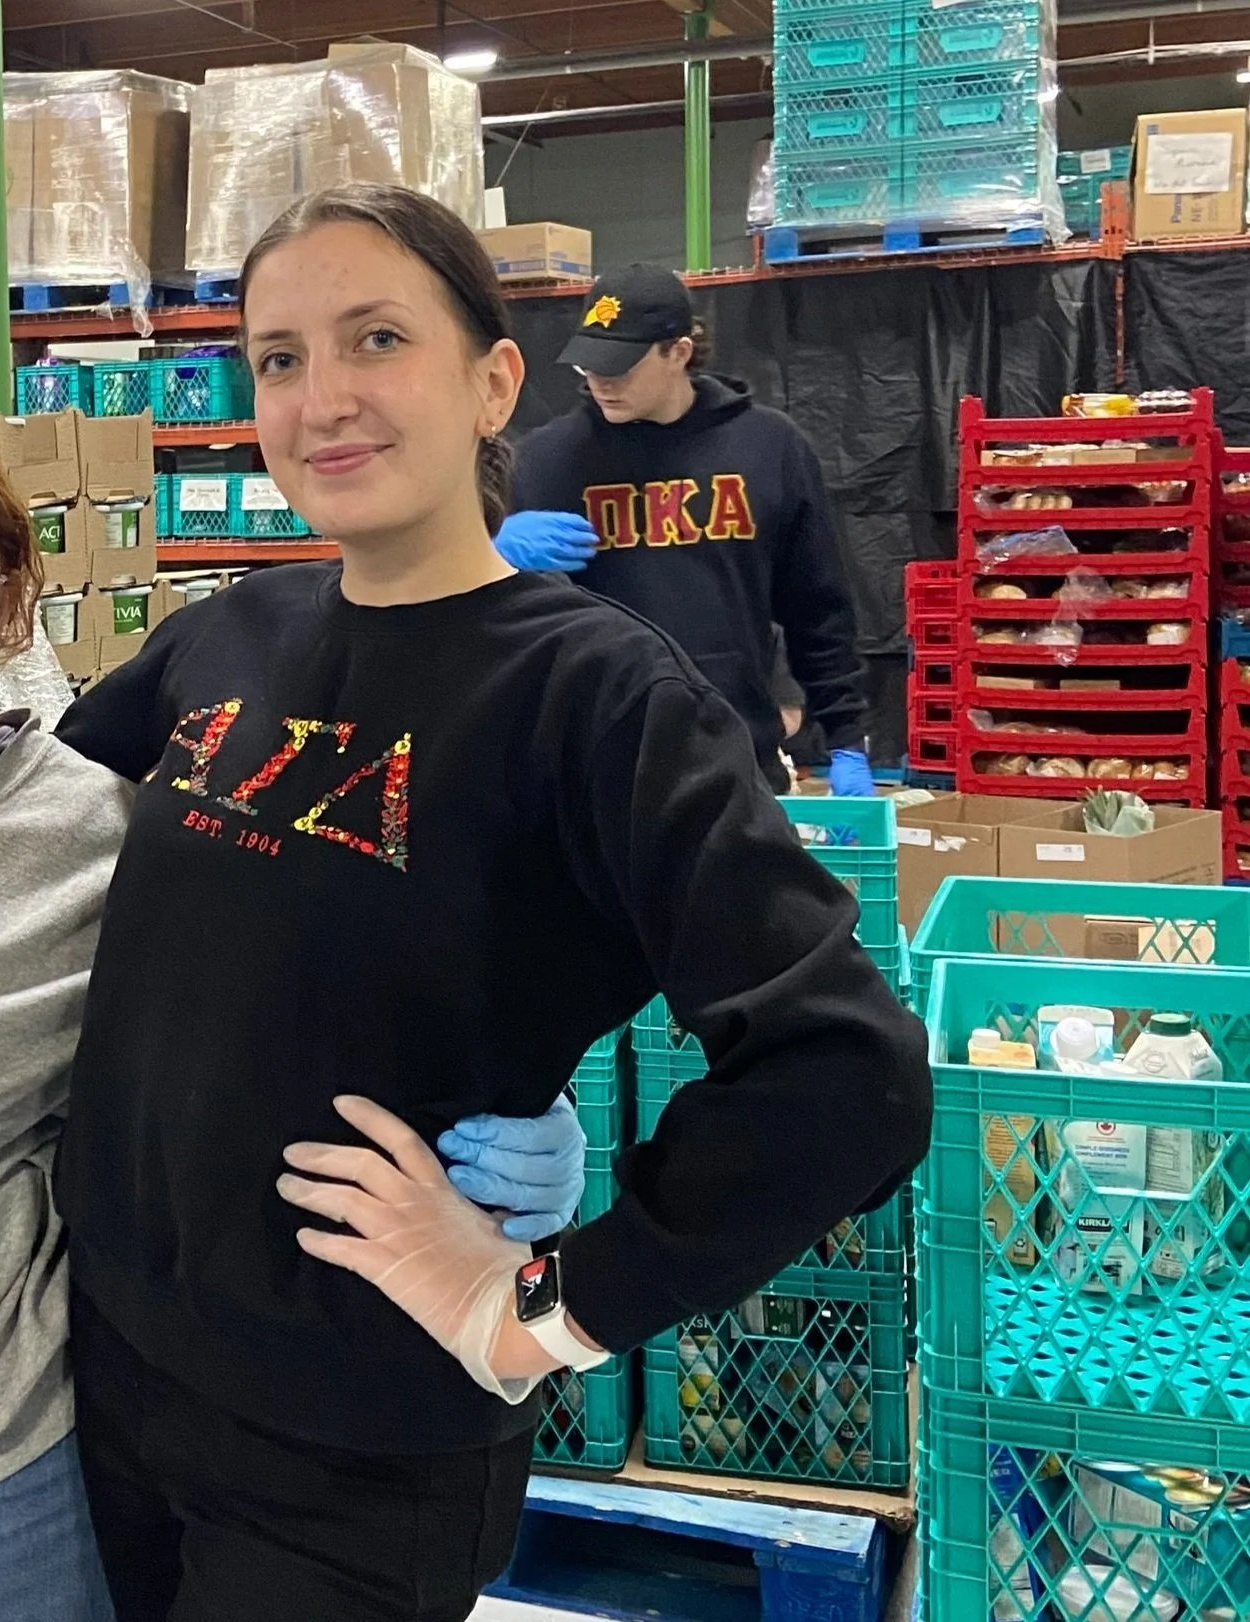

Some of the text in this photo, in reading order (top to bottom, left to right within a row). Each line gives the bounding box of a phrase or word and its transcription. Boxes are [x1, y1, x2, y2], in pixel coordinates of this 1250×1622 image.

[115, 606, 142, 619] IVIA
[182, 809, 282, 856] EST. 1904
[1078, 1216, 1122, 1228] KIRKL
